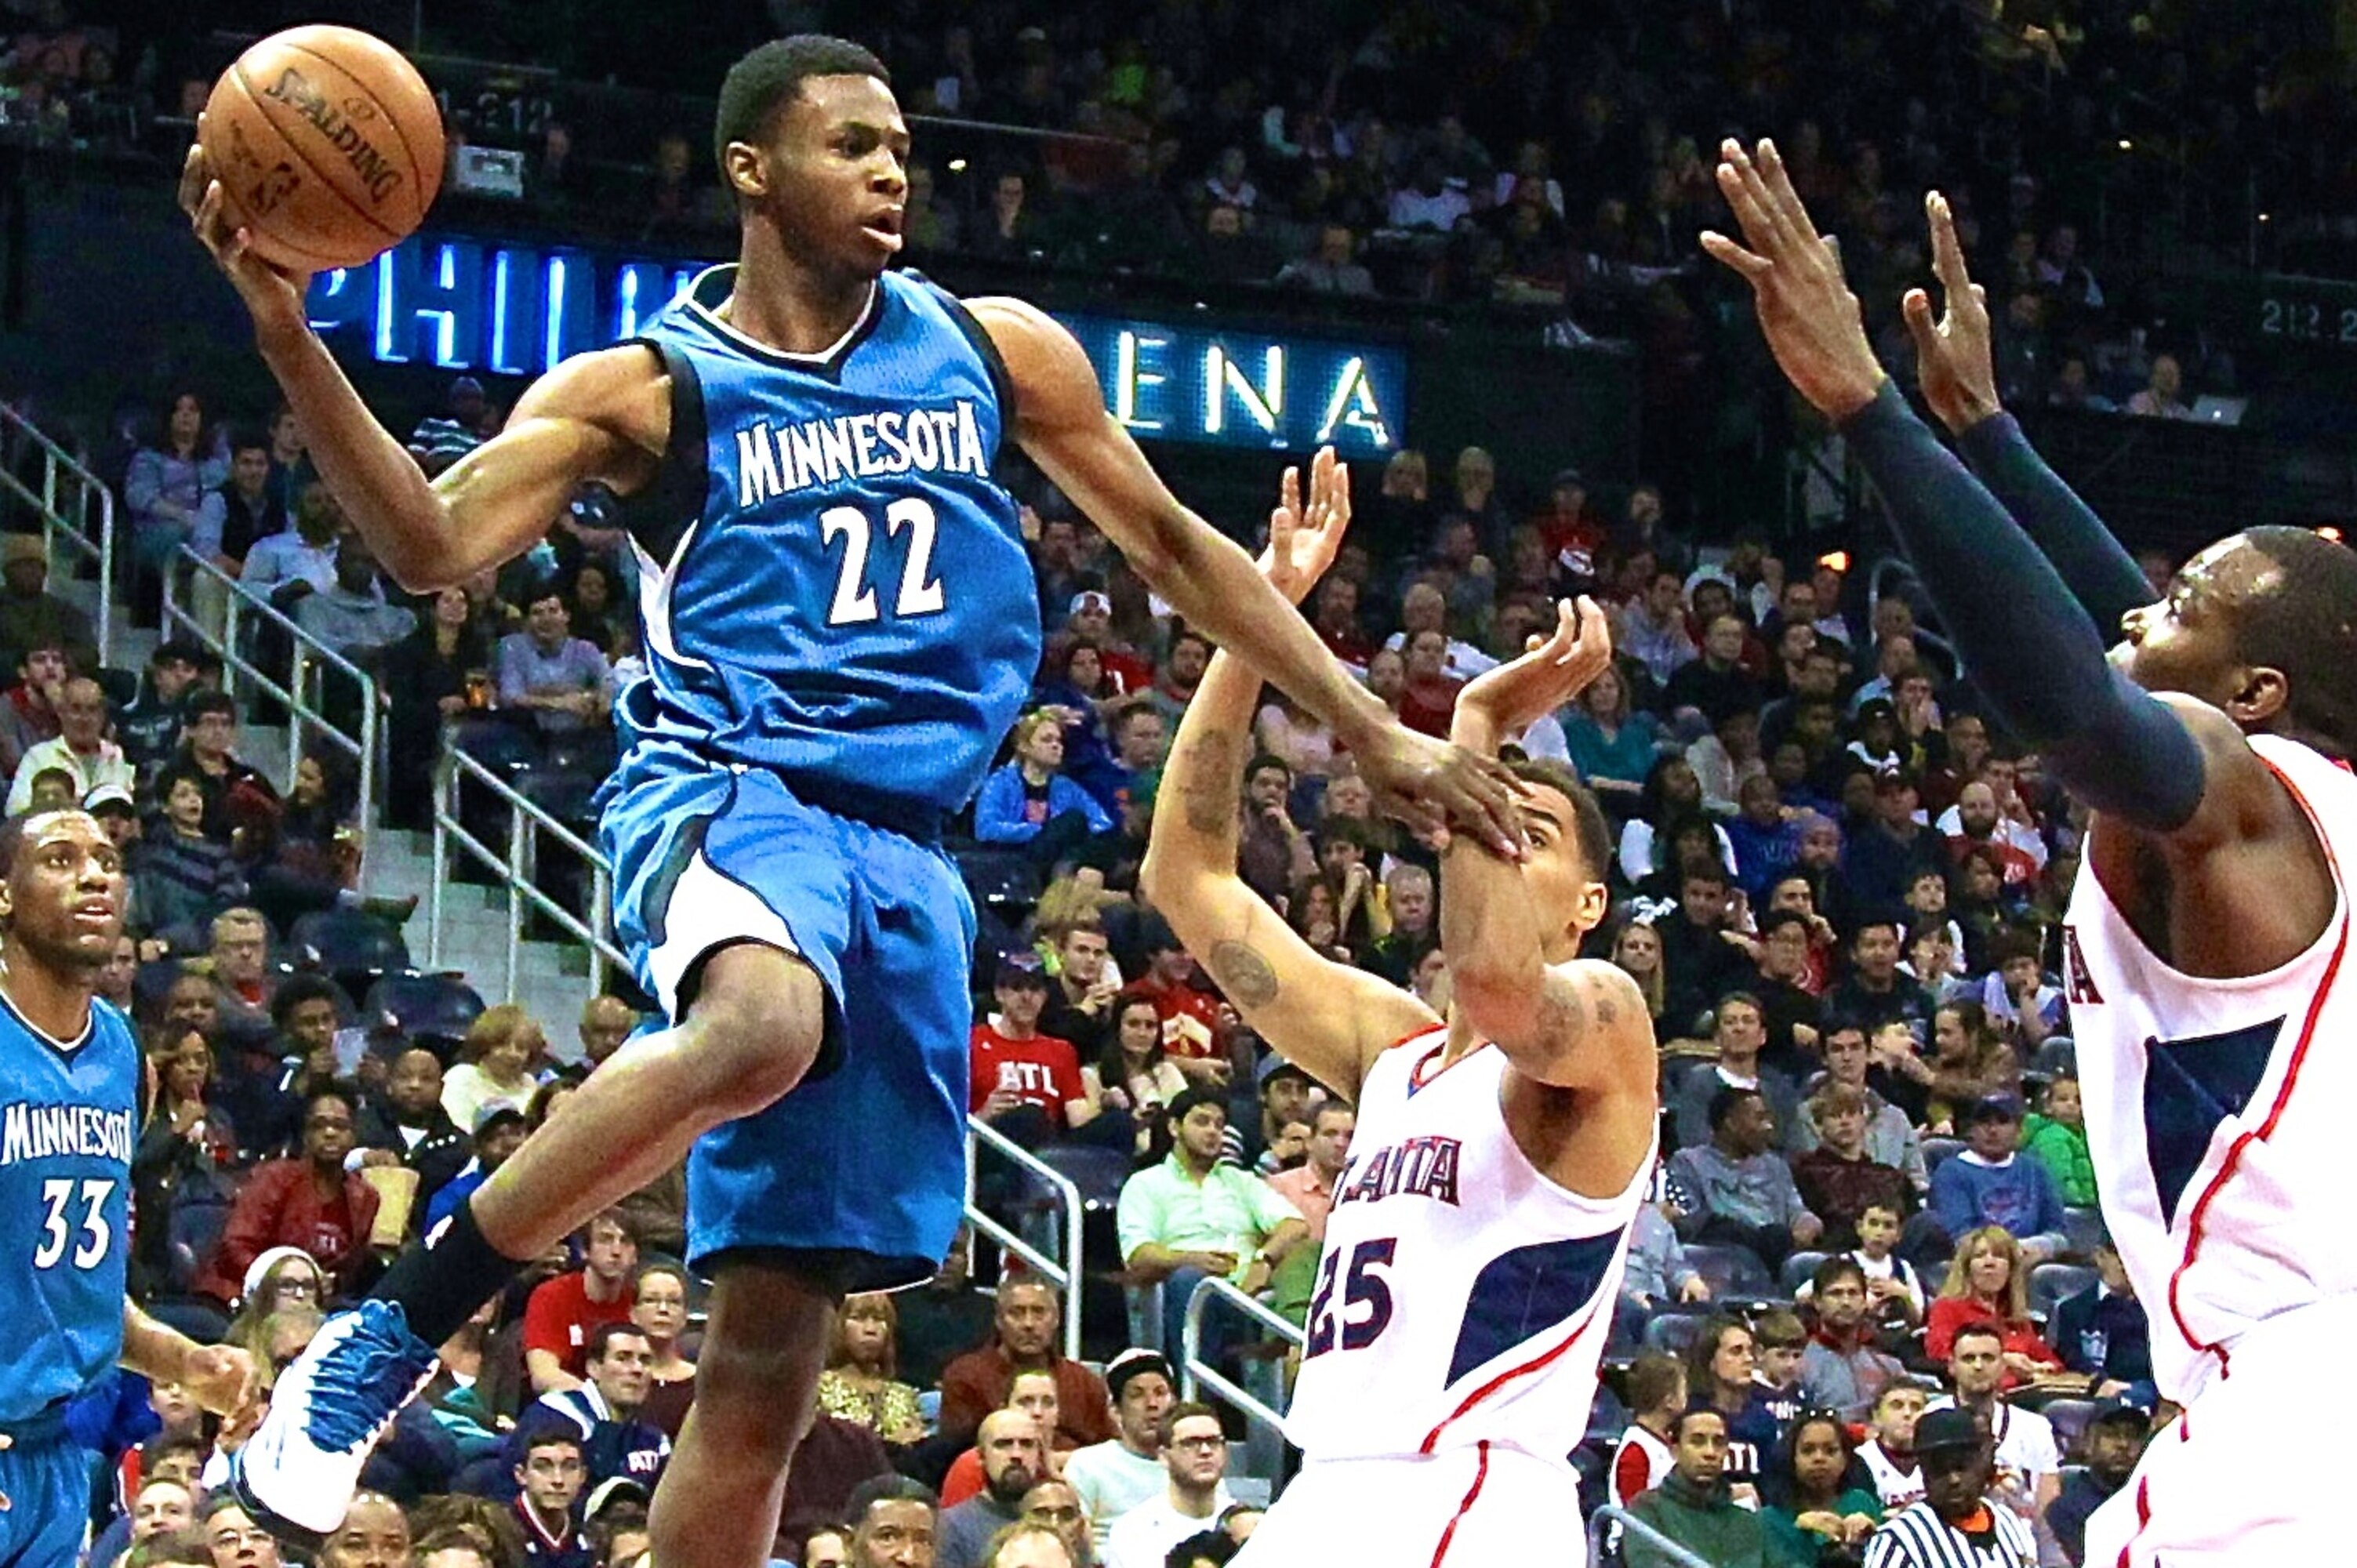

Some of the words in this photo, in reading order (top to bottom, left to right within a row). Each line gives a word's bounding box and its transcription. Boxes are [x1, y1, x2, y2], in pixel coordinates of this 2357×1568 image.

[264, 67, 404, 205] SPALDING
[735, 398, 990, 508] MINNESOTA
[819, 497, 946, 626] 22
[998, 1061, 1059, 1098] ATL
[34, 1178, 116, 1269] 33
